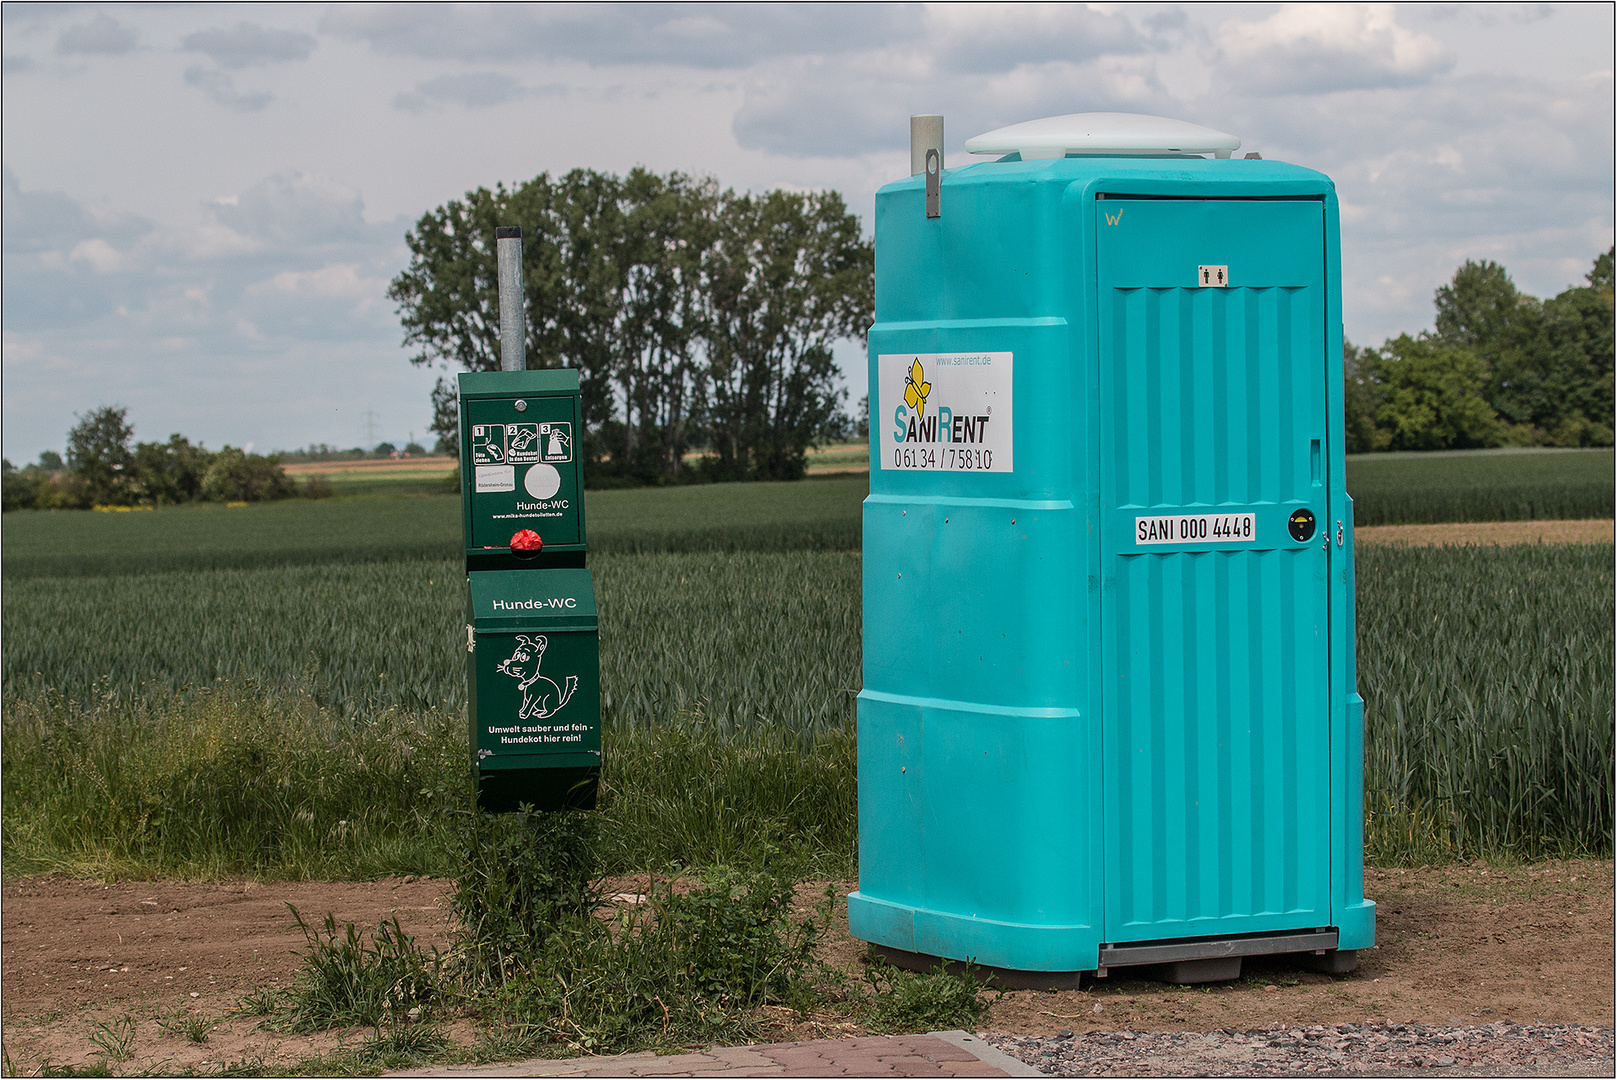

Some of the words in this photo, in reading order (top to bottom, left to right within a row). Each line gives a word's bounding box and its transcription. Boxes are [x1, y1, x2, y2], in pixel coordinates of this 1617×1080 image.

[936, 355, 992, 366] www.sanirent.de
[516, 500, 569, 510] Hunde-WC
[1138, 519, 1174, 541] SANI
[1213, 516, 1251, 538] 4448
[492, 598, 577, 610] Hunde-WC
[488, 725, 521, 734] Umwelt
[521, 724, 551, 733] sauber
[553, 723, 570, 732] und
[571, 723, 588, 731] fein
[501, 734, 542, 744] Hundekot
[543, 733, 561, 743] hier
[562, 733, 582, 743] rein!
